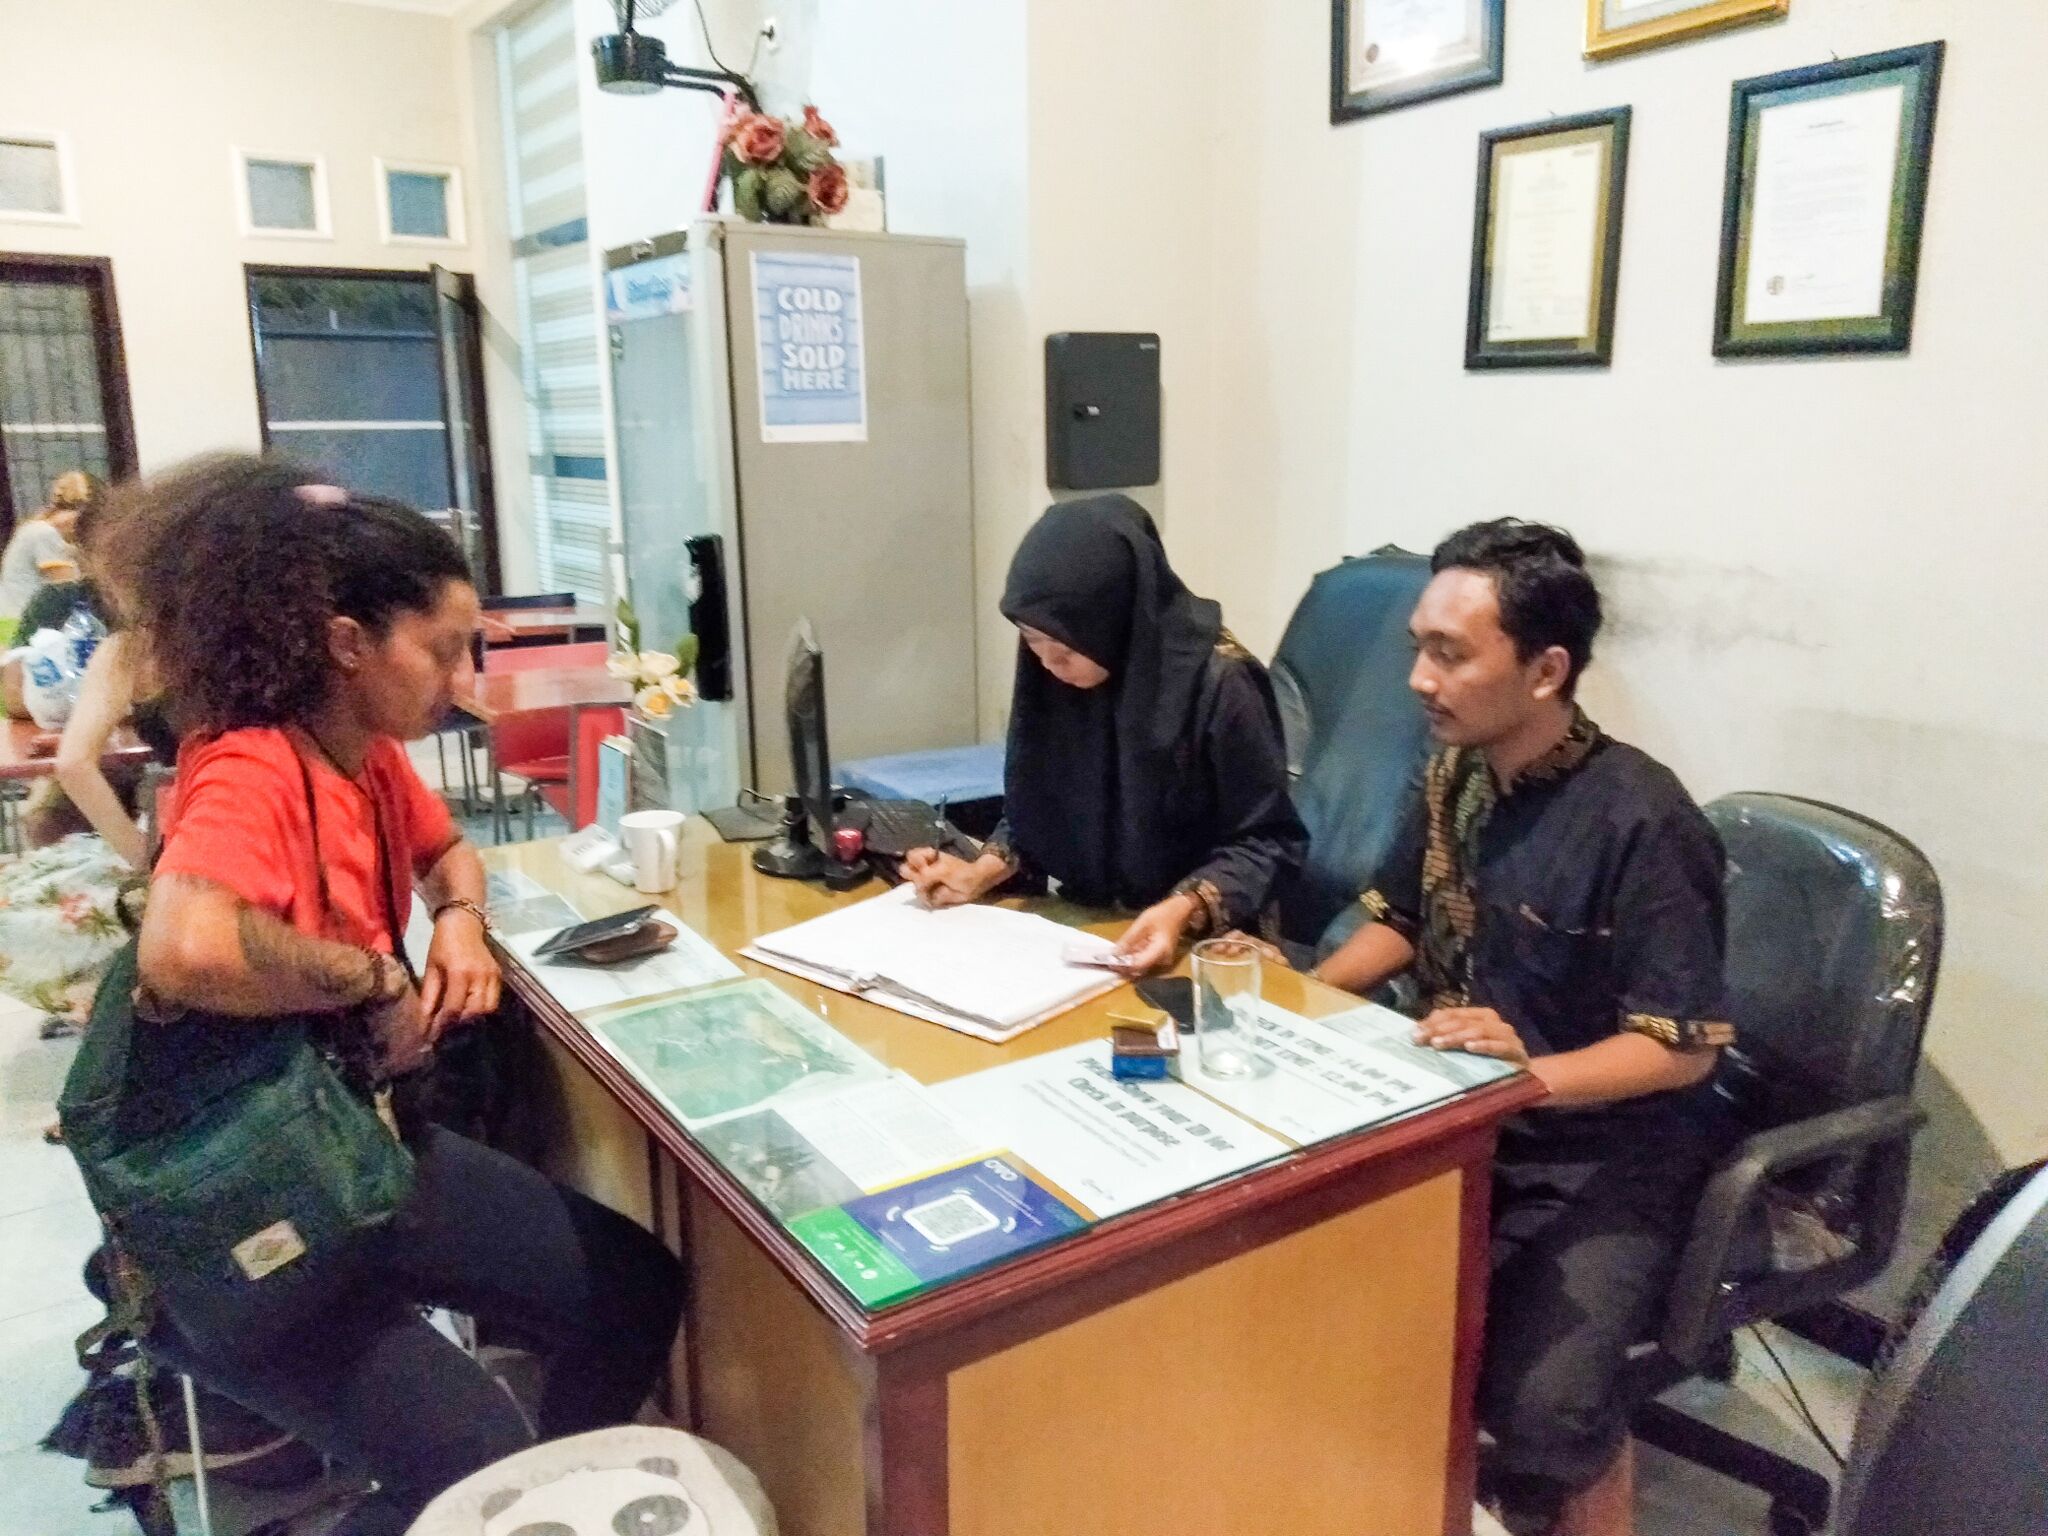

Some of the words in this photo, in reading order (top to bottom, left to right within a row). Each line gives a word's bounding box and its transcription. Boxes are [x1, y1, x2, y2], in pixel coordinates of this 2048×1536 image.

[778, 287, 843, 313] COLD
[780, 342, 846, 370] SOLD
[782, 368, 847, 391] HERE
